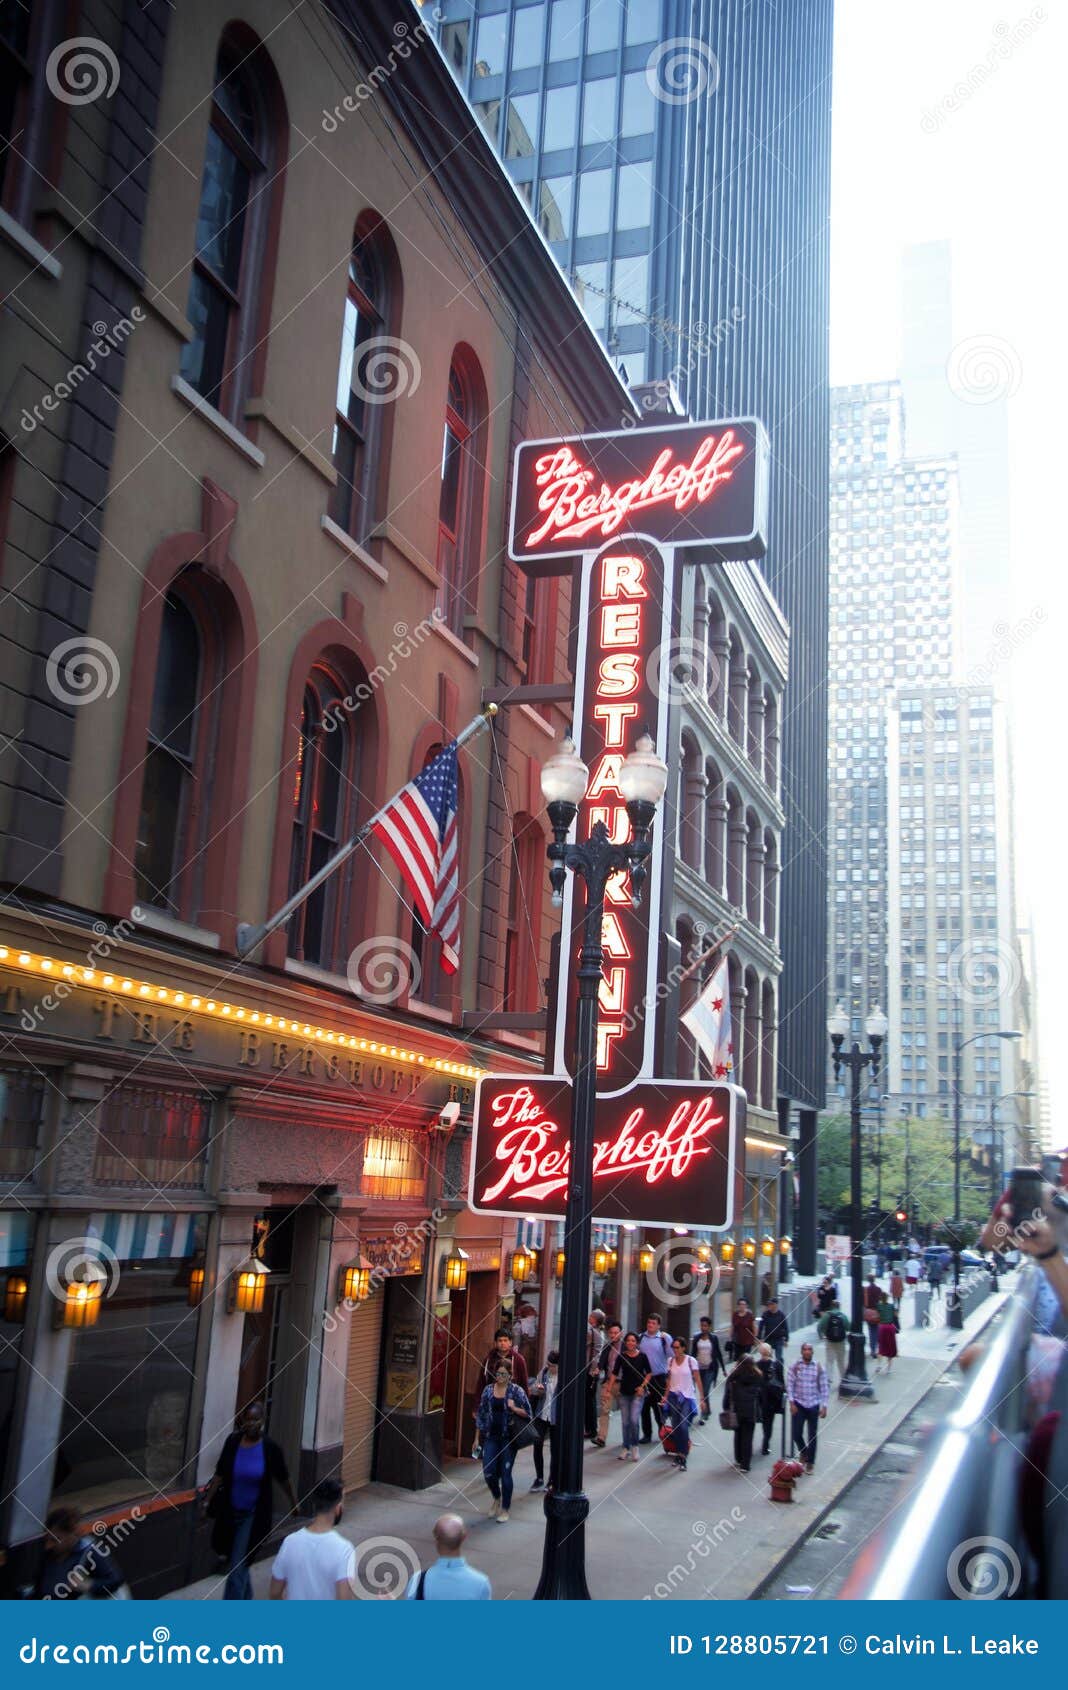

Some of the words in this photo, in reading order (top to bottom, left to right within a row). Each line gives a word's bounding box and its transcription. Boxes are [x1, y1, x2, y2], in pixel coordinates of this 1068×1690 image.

[525, 430, 744, 547] Berghoff
[93, 1000, 194, 1052] THE
[238, 1031, 421, 1097] BERGHOFF
[491, 1086, 544, 1128] The
